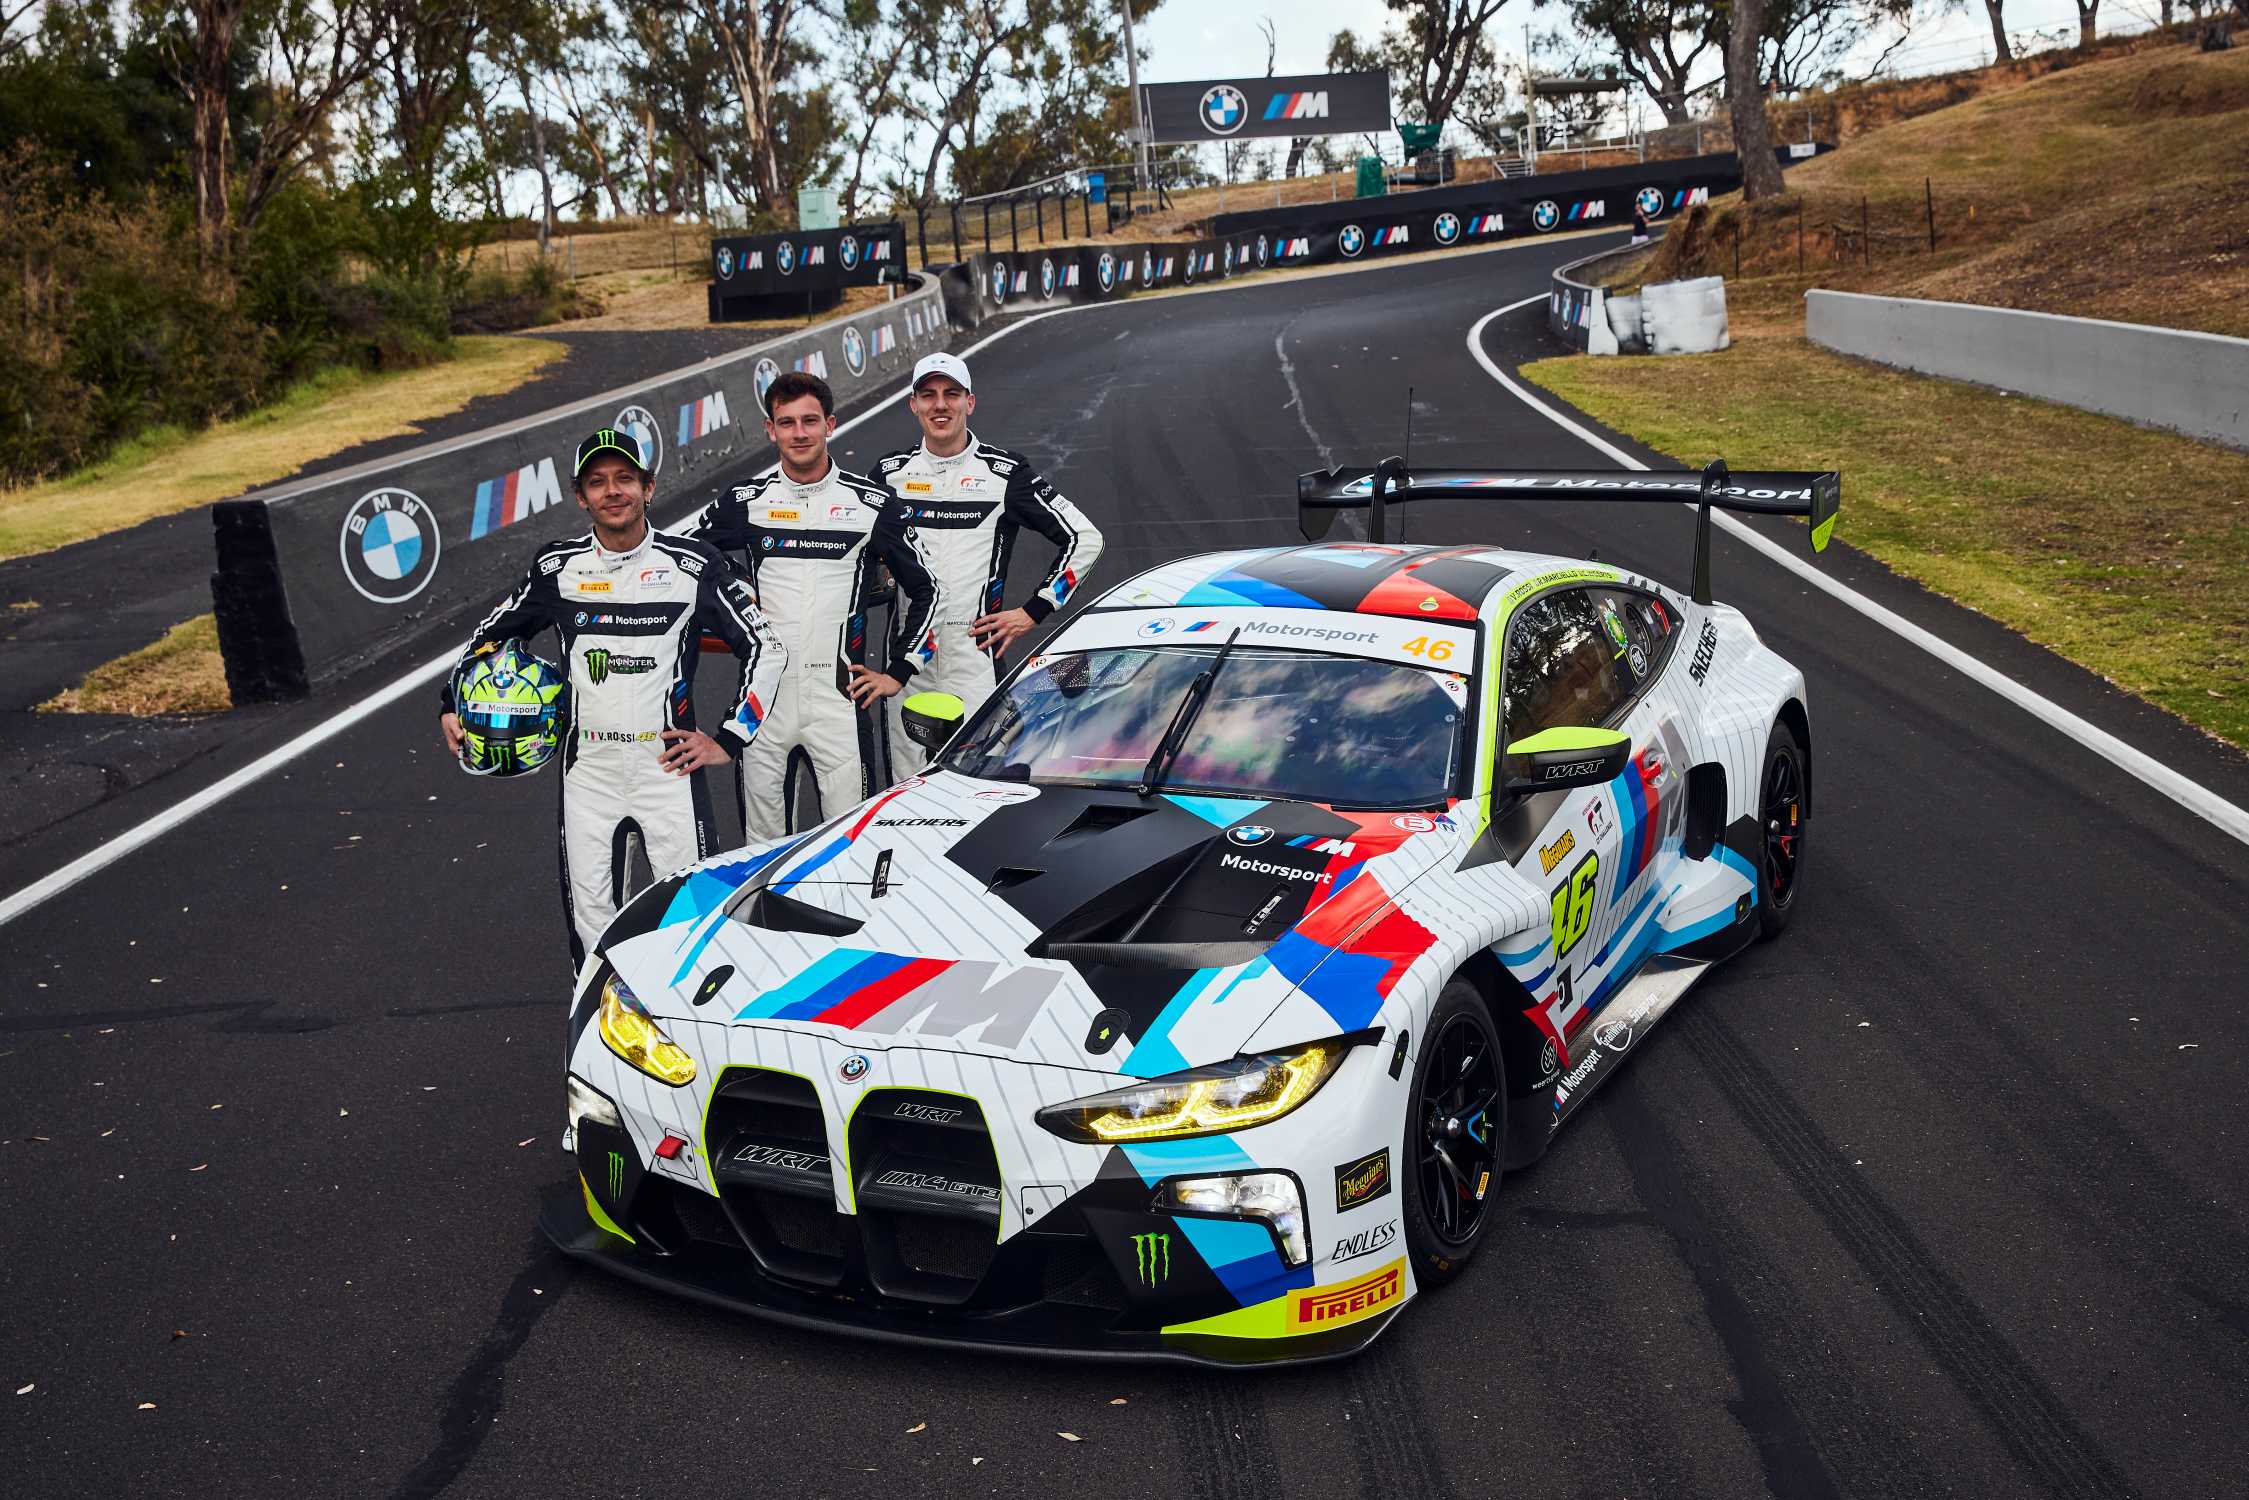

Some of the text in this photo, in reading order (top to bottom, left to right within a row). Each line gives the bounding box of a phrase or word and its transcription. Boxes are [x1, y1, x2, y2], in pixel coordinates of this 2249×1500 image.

[993, 461, 1013, 473] OMP
[735, 490, 756, 499] OMP
[864, 493, 886, 505] OMP
[349, 494, 420, 536] BMW
[936, 510, 982, 520] Motorsport
[799, 540, 847, 551] Motorsport
[540, 557, 562, 574] OMP
[680, 558, 702, 574] OMP
[580, 582, 609, 591] PIRELLI
[615, 614, 668, 626] Motorsport
[1242, 620, 1456, 661] Motorsport 46
[1688, 617, 1719, 688] SKECHERS
[487, 704, 538, 715] Motorsport
[598, 731, 635, 743] V.ROSSI
[1545, 759, 1605, 780] WRT
[872, 818, 970, 828] SKECHERS
[1220, 853, 1333, 884] Motorsport
[1561, 1048, 1603, 1092] Motorsport
[894, 1102, 962, 1123] WRT
[734, 1144, 829, 1171] WRT
[948, 1181, 1001, 1201] GT3
[1331, 1218, 1398, 1261] ENDLESS
[1298, 1267, 1399, 1323] PIRELLI
